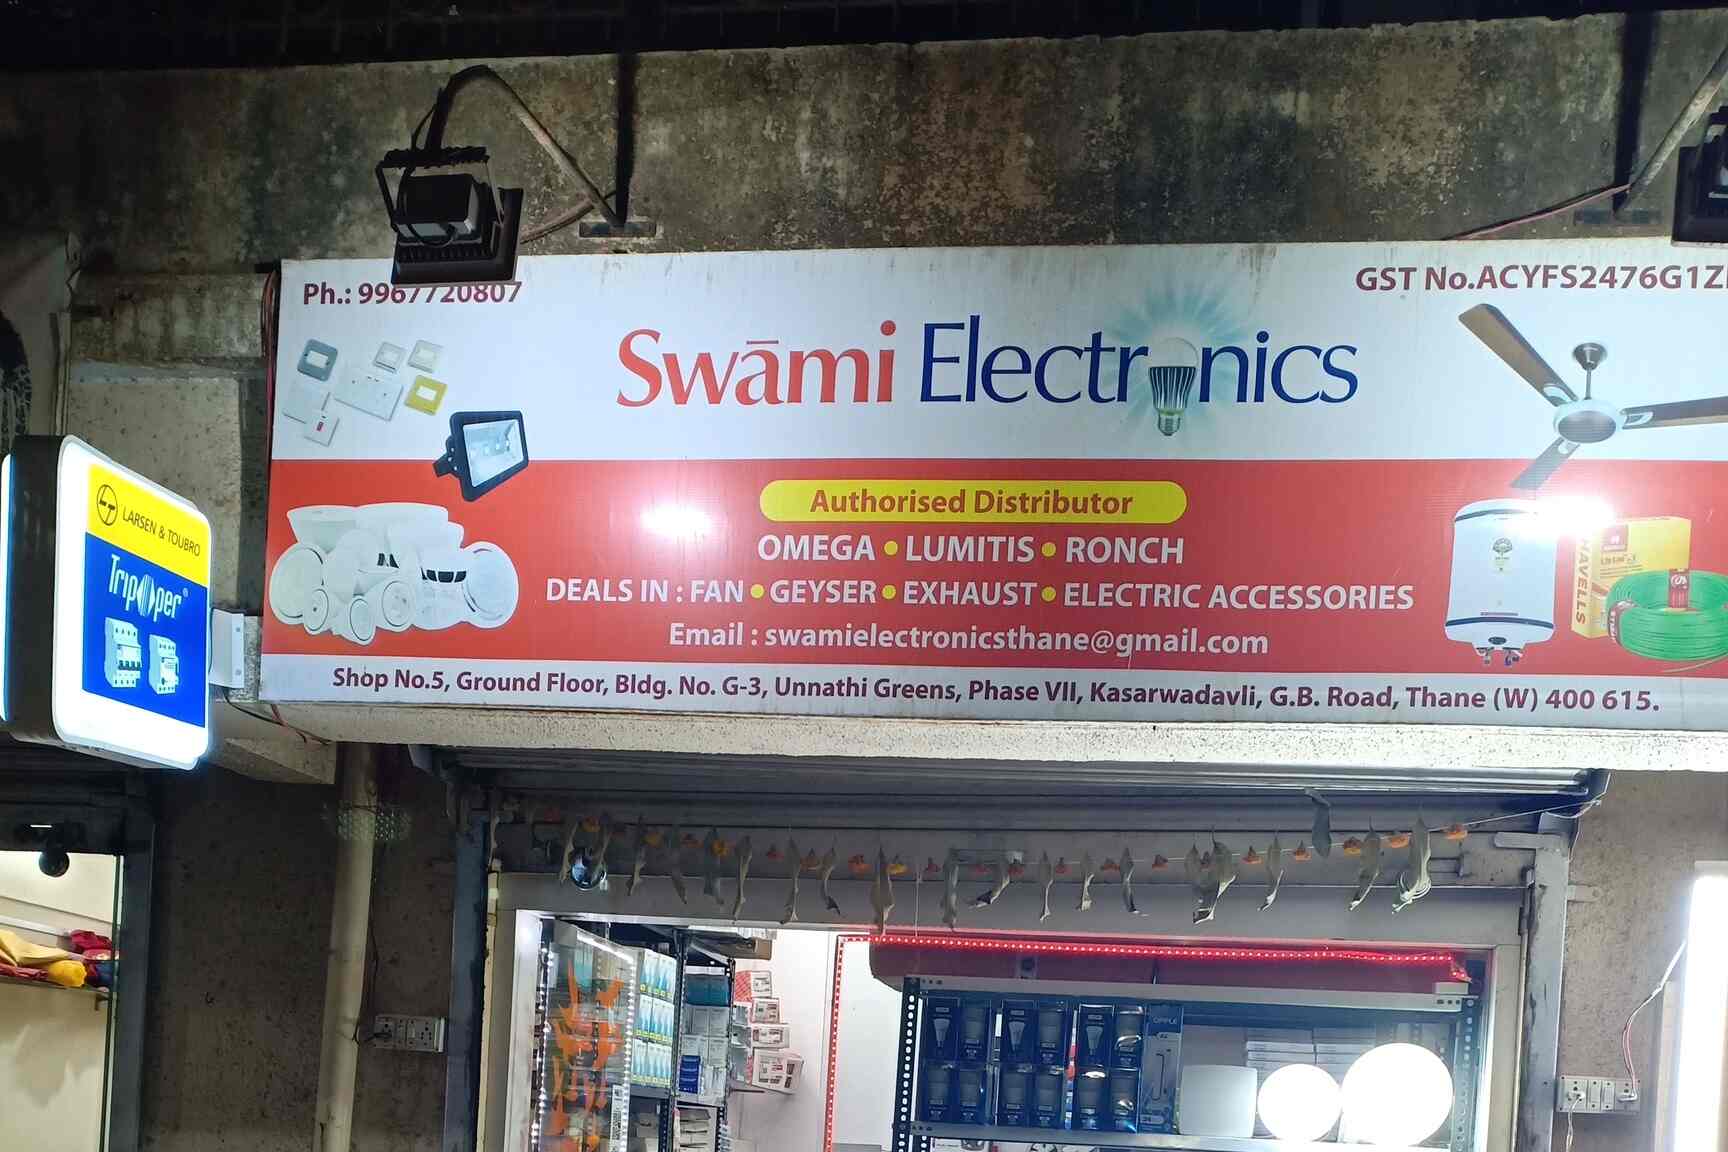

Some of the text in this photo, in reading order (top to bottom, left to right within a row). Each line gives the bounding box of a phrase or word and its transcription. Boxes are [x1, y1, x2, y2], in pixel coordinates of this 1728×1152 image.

[303, 281, 352, 305] Ph.:
[1355, 267, 1416, 290] GST
[810, 489, 1134, 515] Authorised Distributor
[122, 505, 201, 557] LARSEN & TOUBRO
[757, 534, 1185, 565] OMEGA LUMITIS RONCH
[545, 578, 634, 603] DEALS
[640, 579, 669, 603] IN
[690, 579, 745, 604] FAN
[769, 580, 878, 605] GEYSER
[902, 581, 1038, 606] EXHAUST
[1063, 582, 1201, 608] ELECTRIC
[1207, 583, 1415, 611] ACCESSORIES
[669, 621, 744, 647] Email
[764, 622, 1269, 658] swamielectronicsthane@gmail.com
[332, 667, 389, 693] Shop
[394, 669, 450, 693] No.5,
[456, 671, 541, 693] Ground
[546, 672, 609, 696] Floor,
[614, 674, 673, 701] Bldg.
[679, 676, 717, 696] No.
[722, 675, 768, 699] G-3,
[774, 676, 868, 698] Unnathi
[873, 678, 962, 703] Greens,
[968, 679, 1040, 702] Phase
[1045, 681, 1084, 705] VII,
[1090, 680, 1262, 710] Kasarwadavli,
[1269, 685, 1320, 708] G.B.
[1327, 685, 1400, 710] Road,
[1406, 685, 1486, 709] Thane
[1493, 687, 1538, 713] (W)
[1545, 688, 1595, 710] 400
